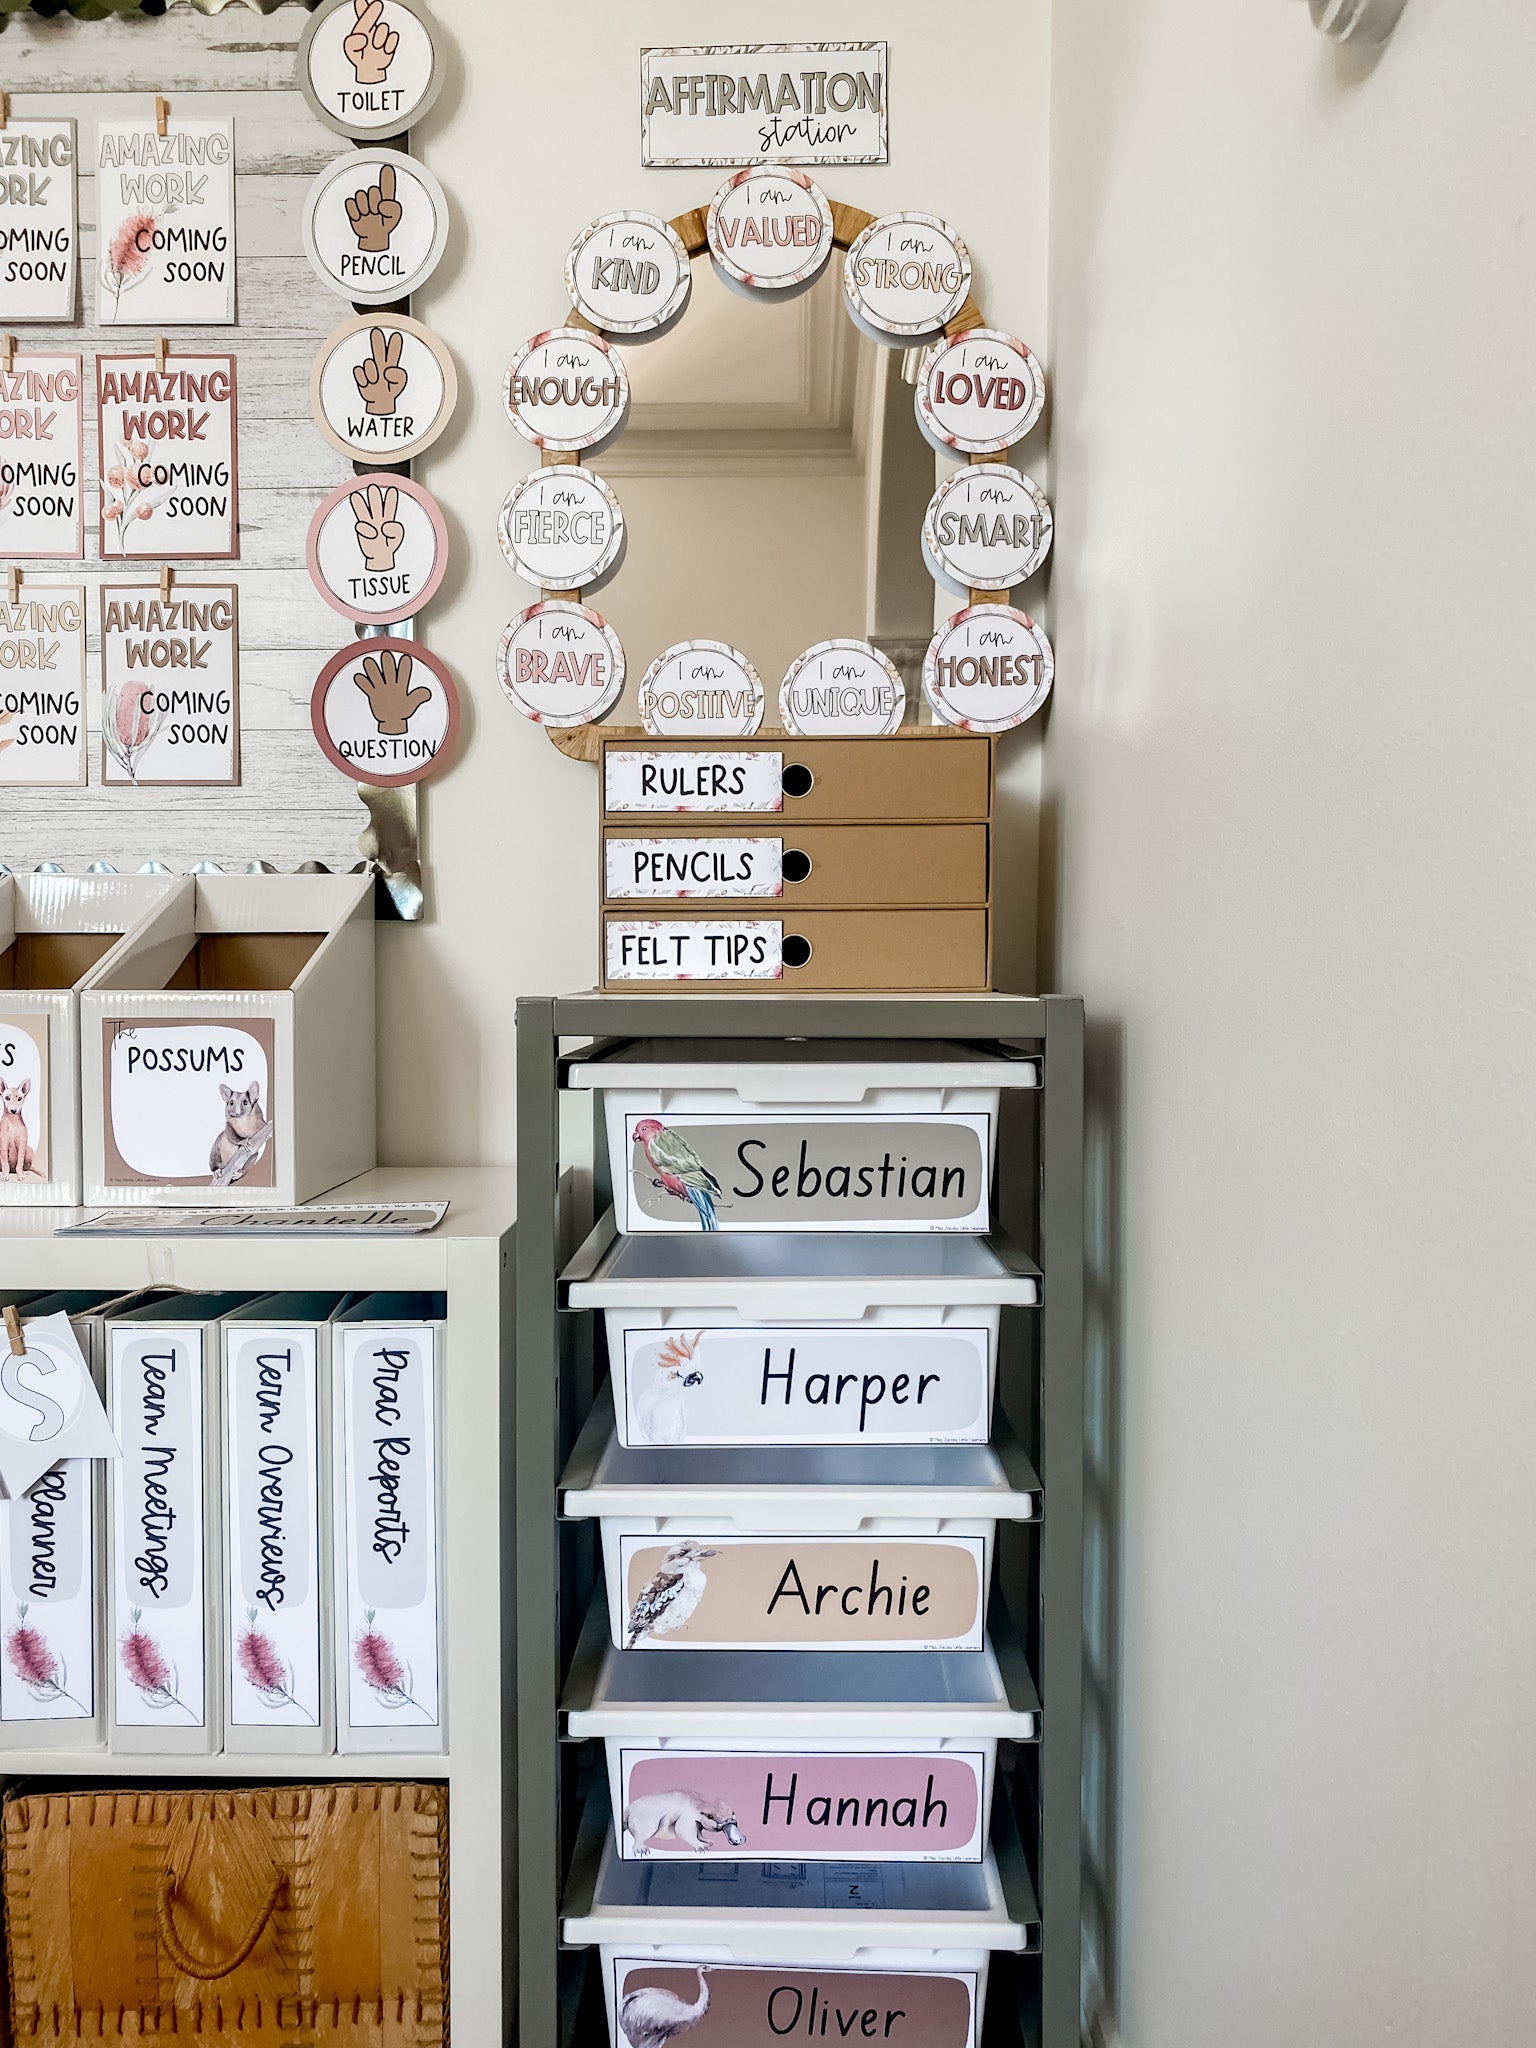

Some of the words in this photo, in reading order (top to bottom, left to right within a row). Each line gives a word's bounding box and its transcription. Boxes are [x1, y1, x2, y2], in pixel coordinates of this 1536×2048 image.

[337, 90, 405, 113] TOILET
[645, 71, 881, 117] AFFIRMATION
[758, 115, 857, 152] station
[0, 134, 72, 168] ZING
[100, 133, 230, 168] AMAZING
[120, 171, 208, 205] WORK
[760, 187, 794, 205] am
[135, 227, 227, 253] COMING
[622, 236, 655, 251] am
[718, 213, 821, 249] VALUED
[900, 239, 934, 255] am
[5, 261, 66, 282] SOON
[164, 262, 225, 283] SOON
[340, 255, 406, 277] PENCIL
[592, 256, 660, 295] KIND
[855, 257, 962, 294] STRONG
[557, 354, 590, 370] am
[973, 354, 1009, 371] am
[102, 370, 231, 403] AMAZING
[508, 375, 621, 408] ENOUGH
[935, 371, 1026, 411] LOVED
[122, 408, 211, 441] WORK
[347, 416, 414, 438] WATER
[138, 462, 229, 488] COMING
[13, 496, 74, 517] SOON
[166, 496, 226, 518] SOON
[553, 490, 586, 507] am
[980, 488, 1013, 505] am
[514, 510, 605, 546] FIERCE
[938, 512, 1043, 551] SMART
[348, 574, 411, 600] TISSUE
[105, 600, 234, 634] AMAZING
[552, 626, 586, 642] am
[980, 631, 1013, 648] am
[125, 638, 213, 670] WORK
[515, 647, 605, 688] BRAVE
[691, 665, 724, 681] am
[832, 665, 866, 681] am
[937, 654, 1043, 688] HONEST
[0, 691, 79, 716] OMING
[140, 690, 230, 715] COMING
[644, 689, 756, 719] POSITIVE
[793, 686, 893, 718] UNIQUE
[16, 724, 77, 745] SOON
[167, 723, 228, 745] SOON
[339, 738, 437, 759] QUESTION
[641, 764, 746, 796] RULERS
[634, 852, 754, 884] PENCILS
[622, 935, 690, 966] FELT
[704, 935, 768, 966] TIPS
[106, 1020, 138, 1051] The
[128, 1046, 245, 1073] POSSUMS
[732, 1139, 966, 1199] Sebastian
[200, 1212, 409, 1227] Chantelle
[1, 1347, 65, 1441] S
[141, 1348, 176, 1436] Team
[256, 1348, 291, 1433] Term
[372, 1347, 408, 1427] Prac
[760, 1347, 941, 1432] Harper
[369, 1437, 411, 1564] Reports
[135, 1447, 176, 1599] Meetings
[256, 1445, 293, 1611] Overviews
[767, 1559, 930, 1617] Archie
[762, 1772, 948, 1828] Hannah
[767, 1985, 906, 2038] Oliver
